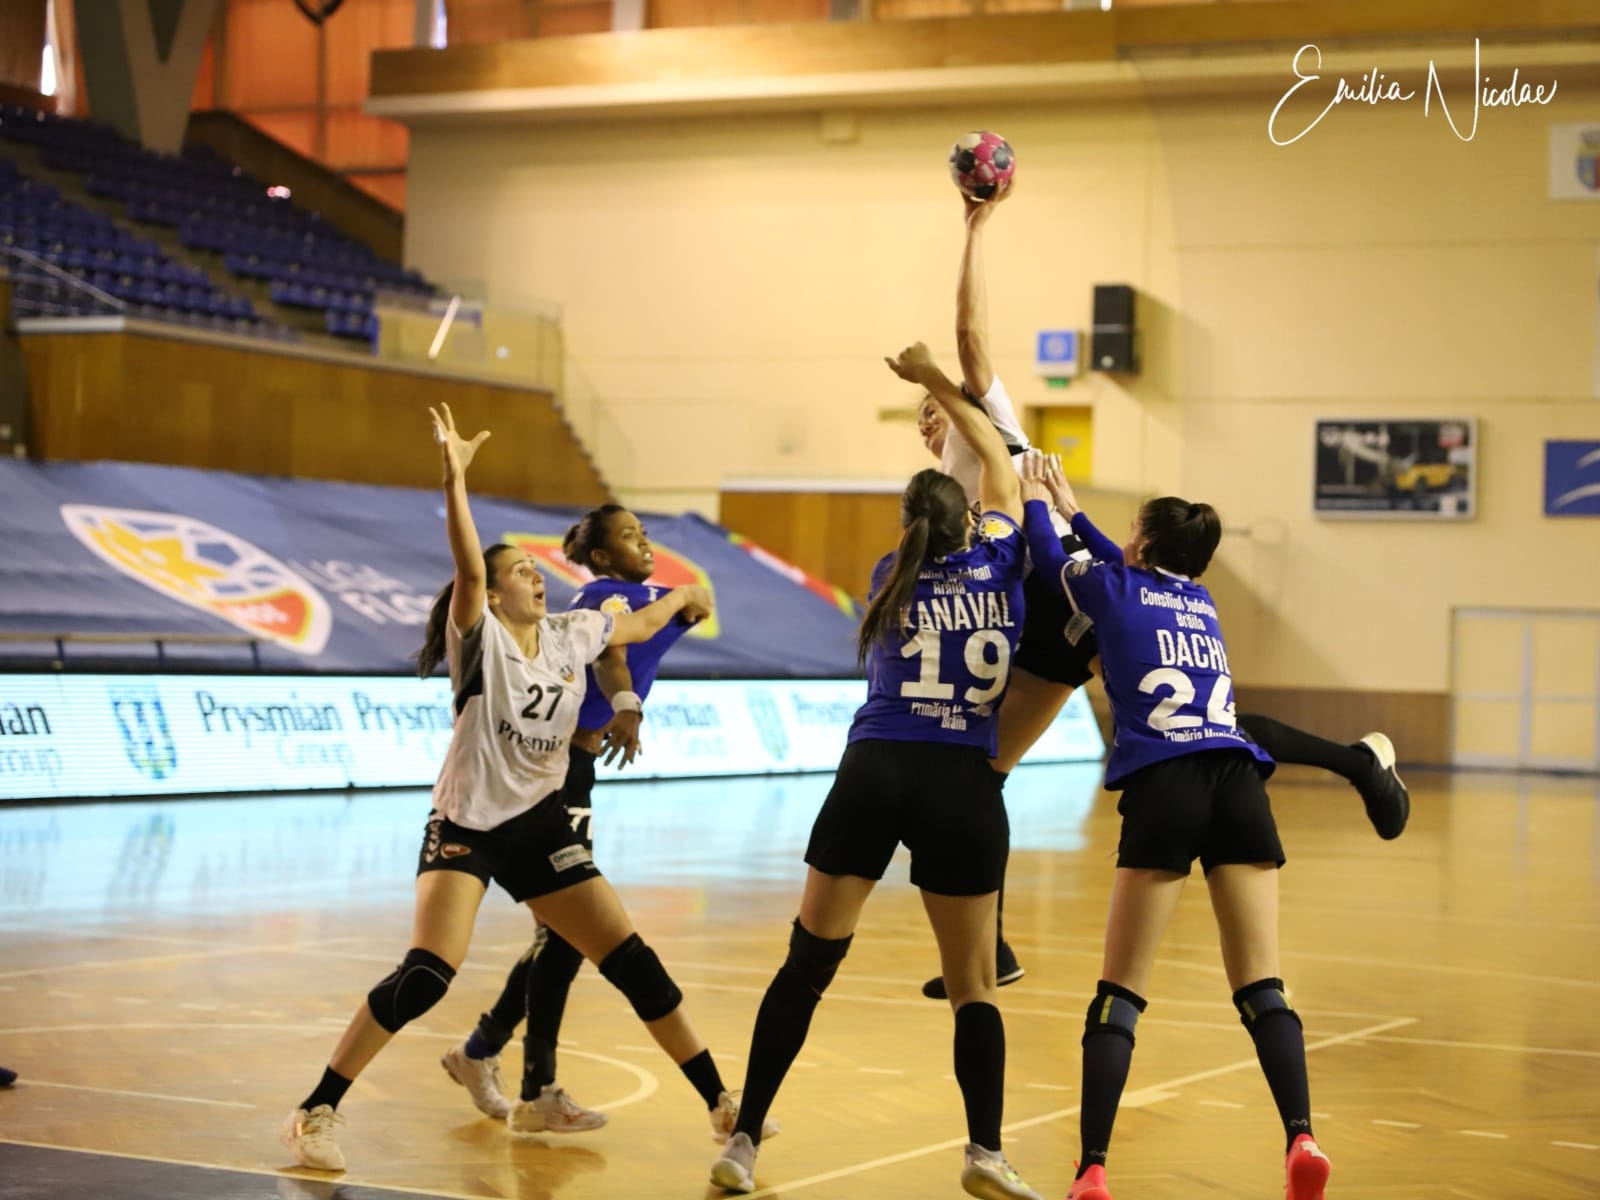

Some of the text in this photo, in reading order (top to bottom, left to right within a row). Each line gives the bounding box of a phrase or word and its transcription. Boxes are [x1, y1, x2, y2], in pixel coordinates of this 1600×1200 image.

[900, 629, 1011, 705] 19
[194, 690, 455, 749] Prysmian Prysmi
[521, 683, 564, 722] 27
[1137, 667, 1237, 731] 24
[498, 719, 563, 752] Prysmi
